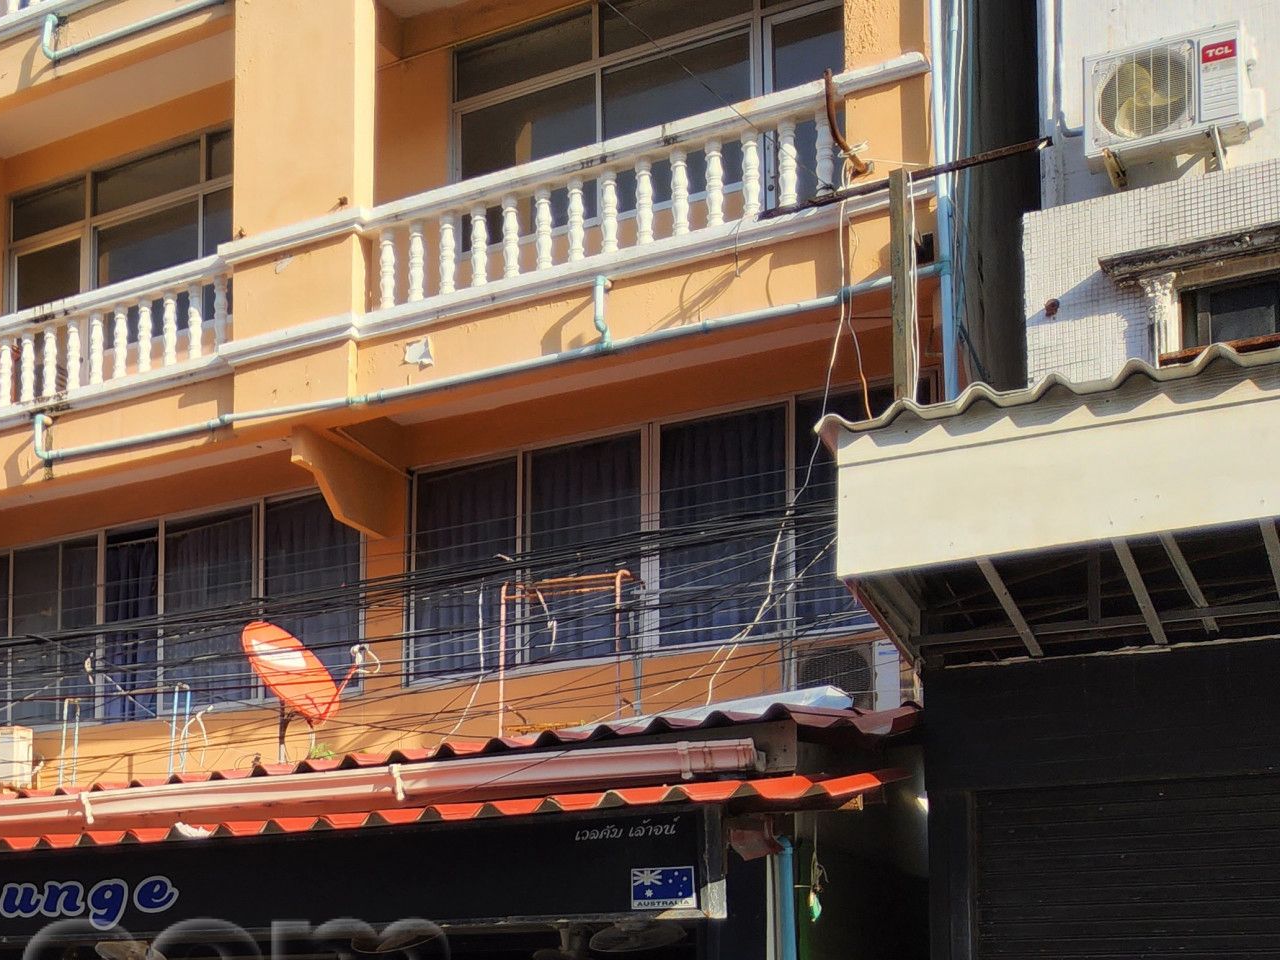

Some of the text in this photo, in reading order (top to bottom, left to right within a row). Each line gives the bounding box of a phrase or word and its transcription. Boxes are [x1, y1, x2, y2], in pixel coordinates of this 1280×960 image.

[1206, 46, 1233, 57] TCL
[575, 815, 681, 841] เวลคัม เล้าจน์
